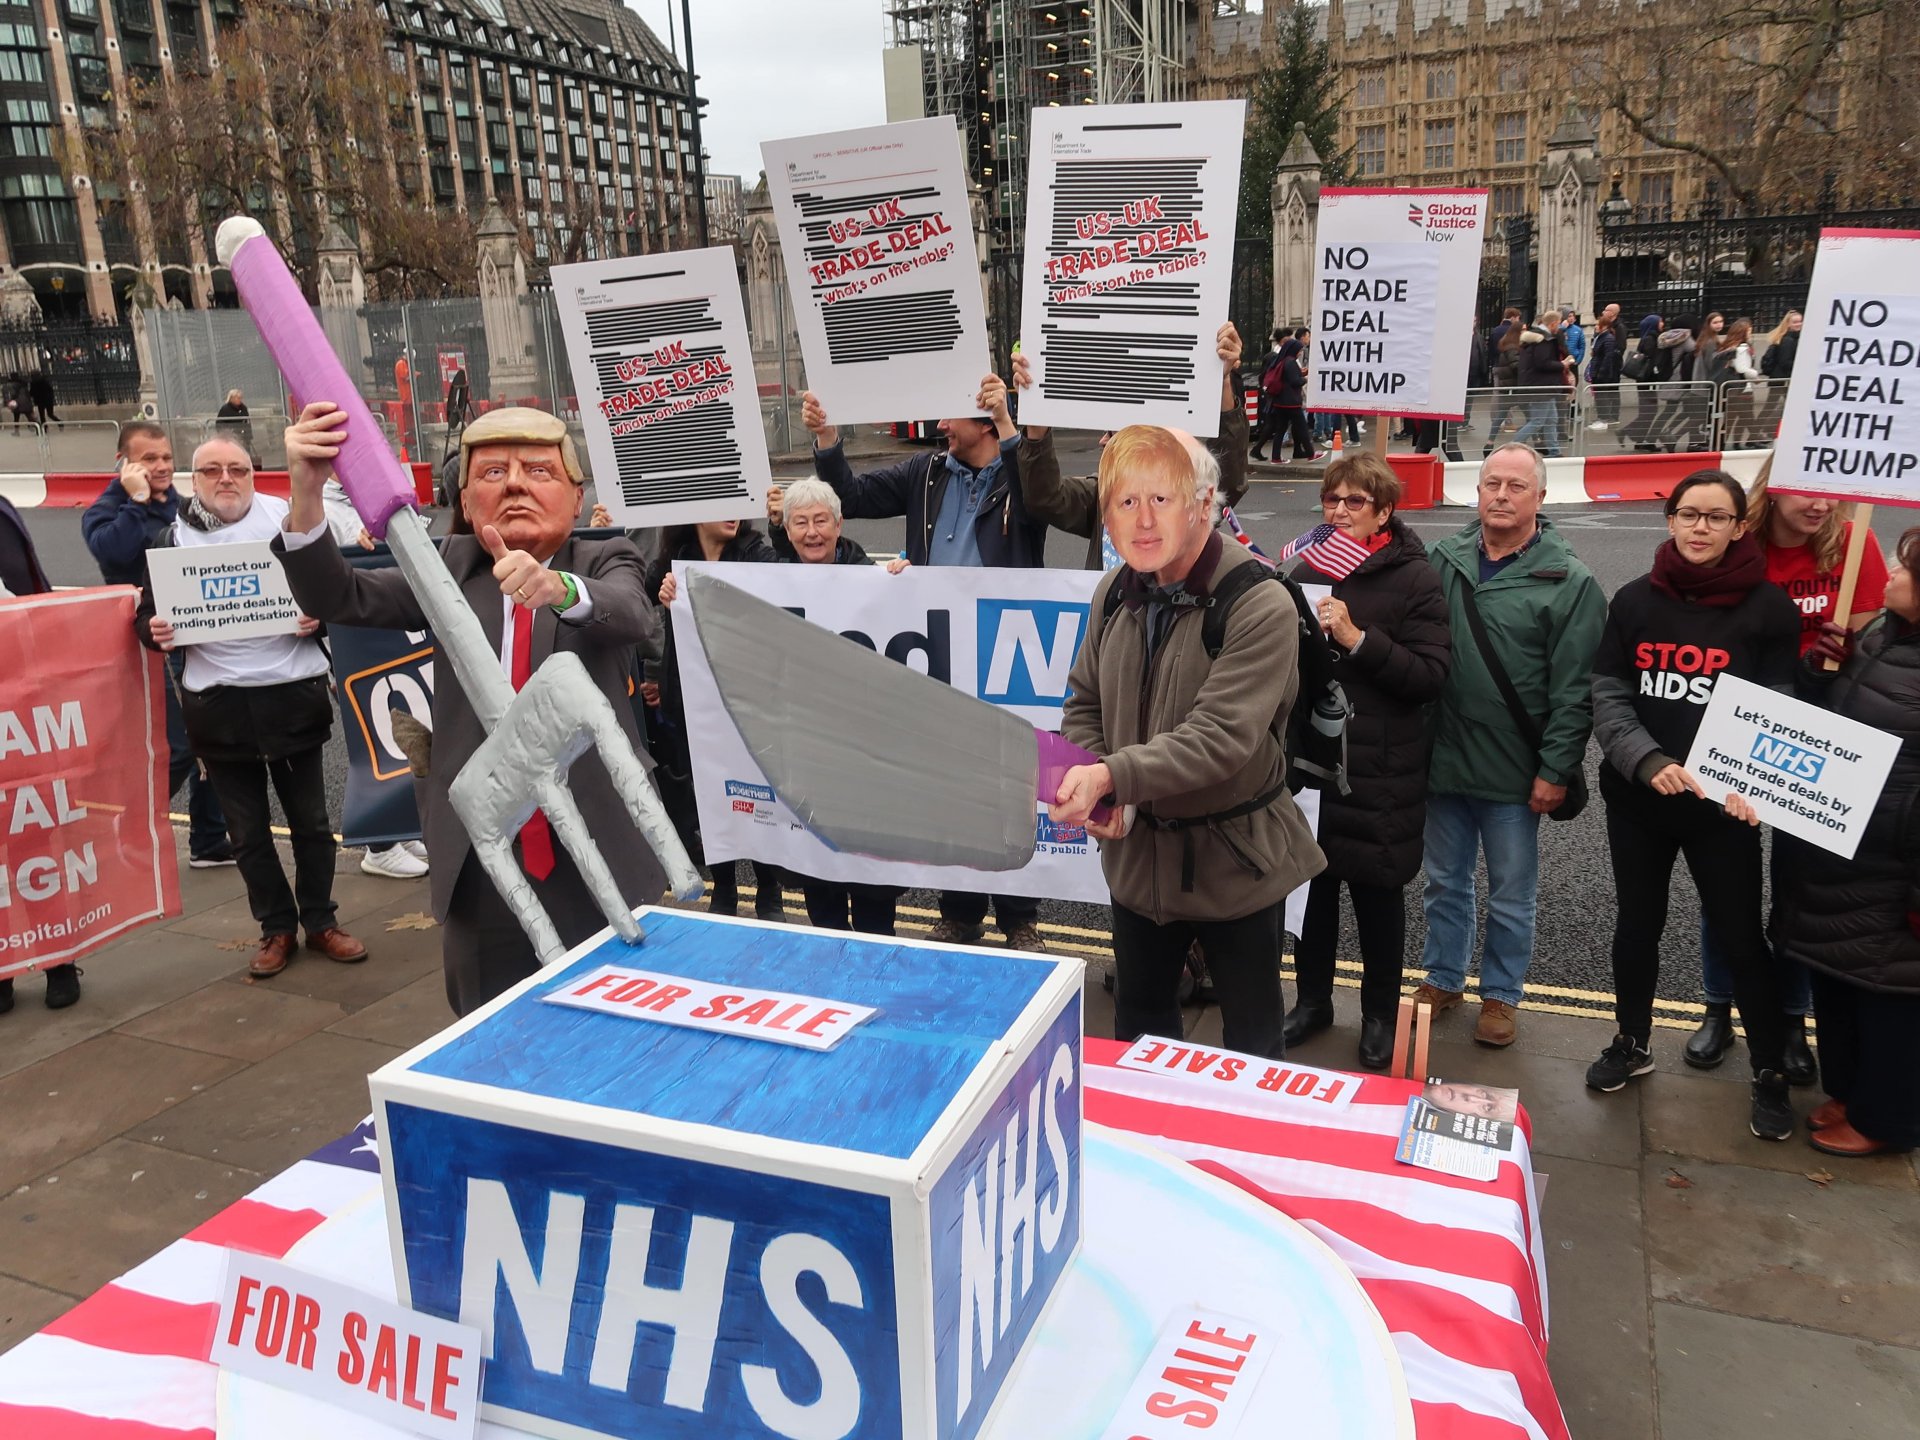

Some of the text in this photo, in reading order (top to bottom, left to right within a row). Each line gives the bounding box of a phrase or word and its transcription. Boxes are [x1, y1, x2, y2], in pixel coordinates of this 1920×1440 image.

[828, 197, 906, 245] US-UK
[1076, 196, 1163, 239] US-UK
[1425, 217, 1476, 229] Justice
[1427, 203, 1477, 216] Global
[809, 214, 952, 285] TRADE DEAL
[1045, 219, 1209, 281] TRADE DEAL
[1425, 230, 1455, 242] Now
[870, 272, 887, 286] on
[889, 261, 911, 278] the
[912, 242, 955, 268] table?
[1107, 275, 1127, 289] on
[1130, 265, 1154, 283] the
[1158, 251, 1207, 276] table?
[1324, 246, 1369, 270] NO
[1322, 279, 1408, 302] TRADE
[1322, 310, 1389, 333] DEAL
[1829, 299, 1889, 328] NO
[615, 340, 689, 382] US-UK
[1320, 340, 1384, 363] WITH
[1824, 336, 1920, 368] TRAD
[598, 355, 732, 418] TRADE DEAL
[656, 406, 672, 418] on
[673, 396, 694, 411] the
[695, 380, 735, 404] table?
[1318, 370, 1406, 394] TRUMP
[1815, 373, 1905, 405] DEAL
[1810, 410, 1893, 441] WITH
[1802, 446, 1919, 479] TRUMP
[182, 561, 272, 577] I'll protect our
[204, 576, 257, 598] NHS
[171, 596, 293, 616] from trade deals by
[172, 609, 298, 630] ending privatisation
[1635, 642, 1730, 675] STOP
[1640, 670, 1712, 705] AIDS
[1734, 706, 1863, 763] Let's protect our
[1752, 736, 1824, 778] NHS
[1699, 765, 1847, 833] ending privatisation
[1708, 748, 1852, 816] from trade deals by
[0, 779, 88, 835] AL
[1050, 845, 1087, 855] public
[571, 974, 852, 1038] FOR SALE
[1133, 1041, 1346, 1103] FOR SALE
[957, 1041, 1075, 1426] NHS
[459, 1176, 866, 1440] NHS
[226, 1276, 463, 1422] FOR SALE
[1146, 1320, 1257, 1429] SALE
